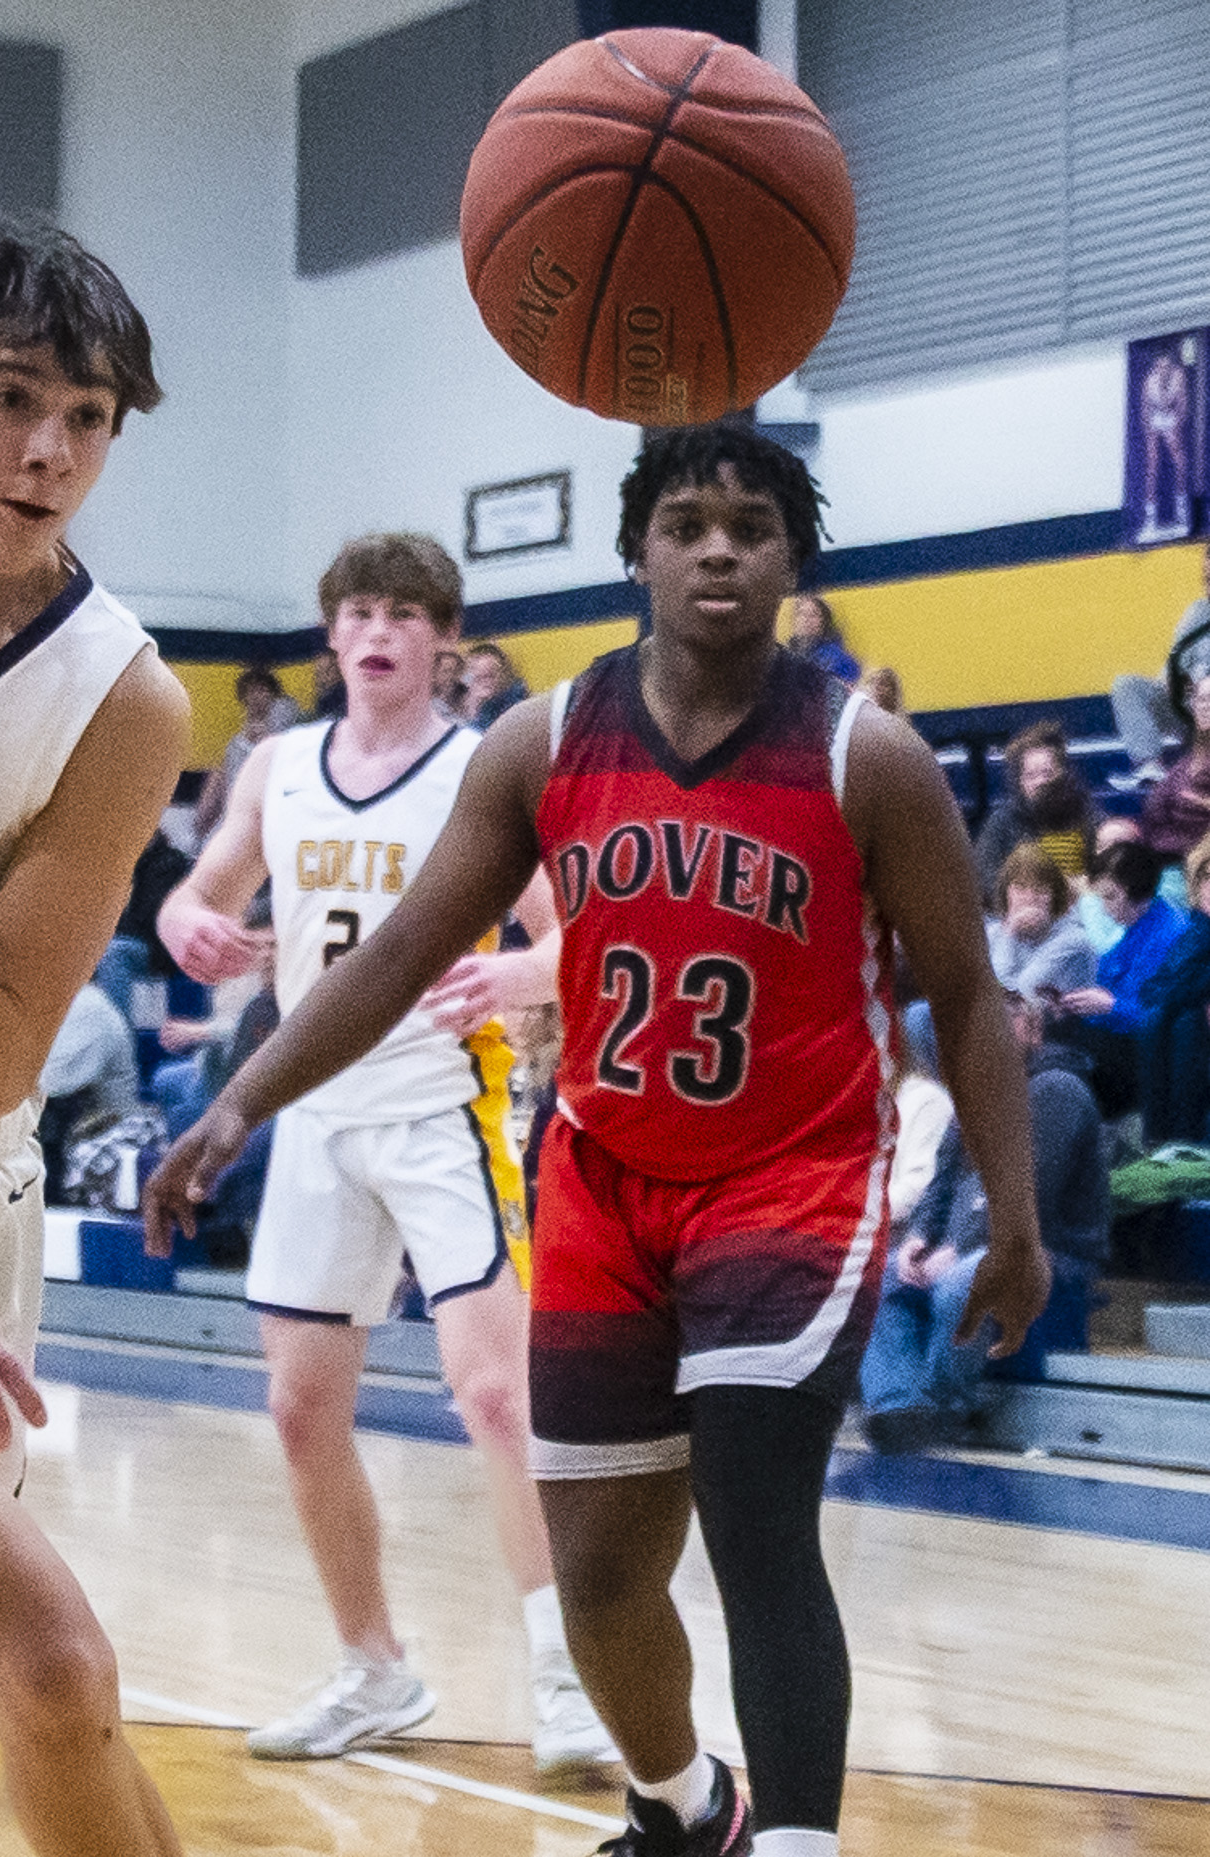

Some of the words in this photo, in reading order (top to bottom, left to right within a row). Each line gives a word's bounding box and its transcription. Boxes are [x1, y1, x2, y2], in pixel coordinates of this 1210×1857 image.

[296, 839, 407, 893] COLTS
[553, 819, 813, 945] DOVER
[595, 942, 756, 1106] 23
